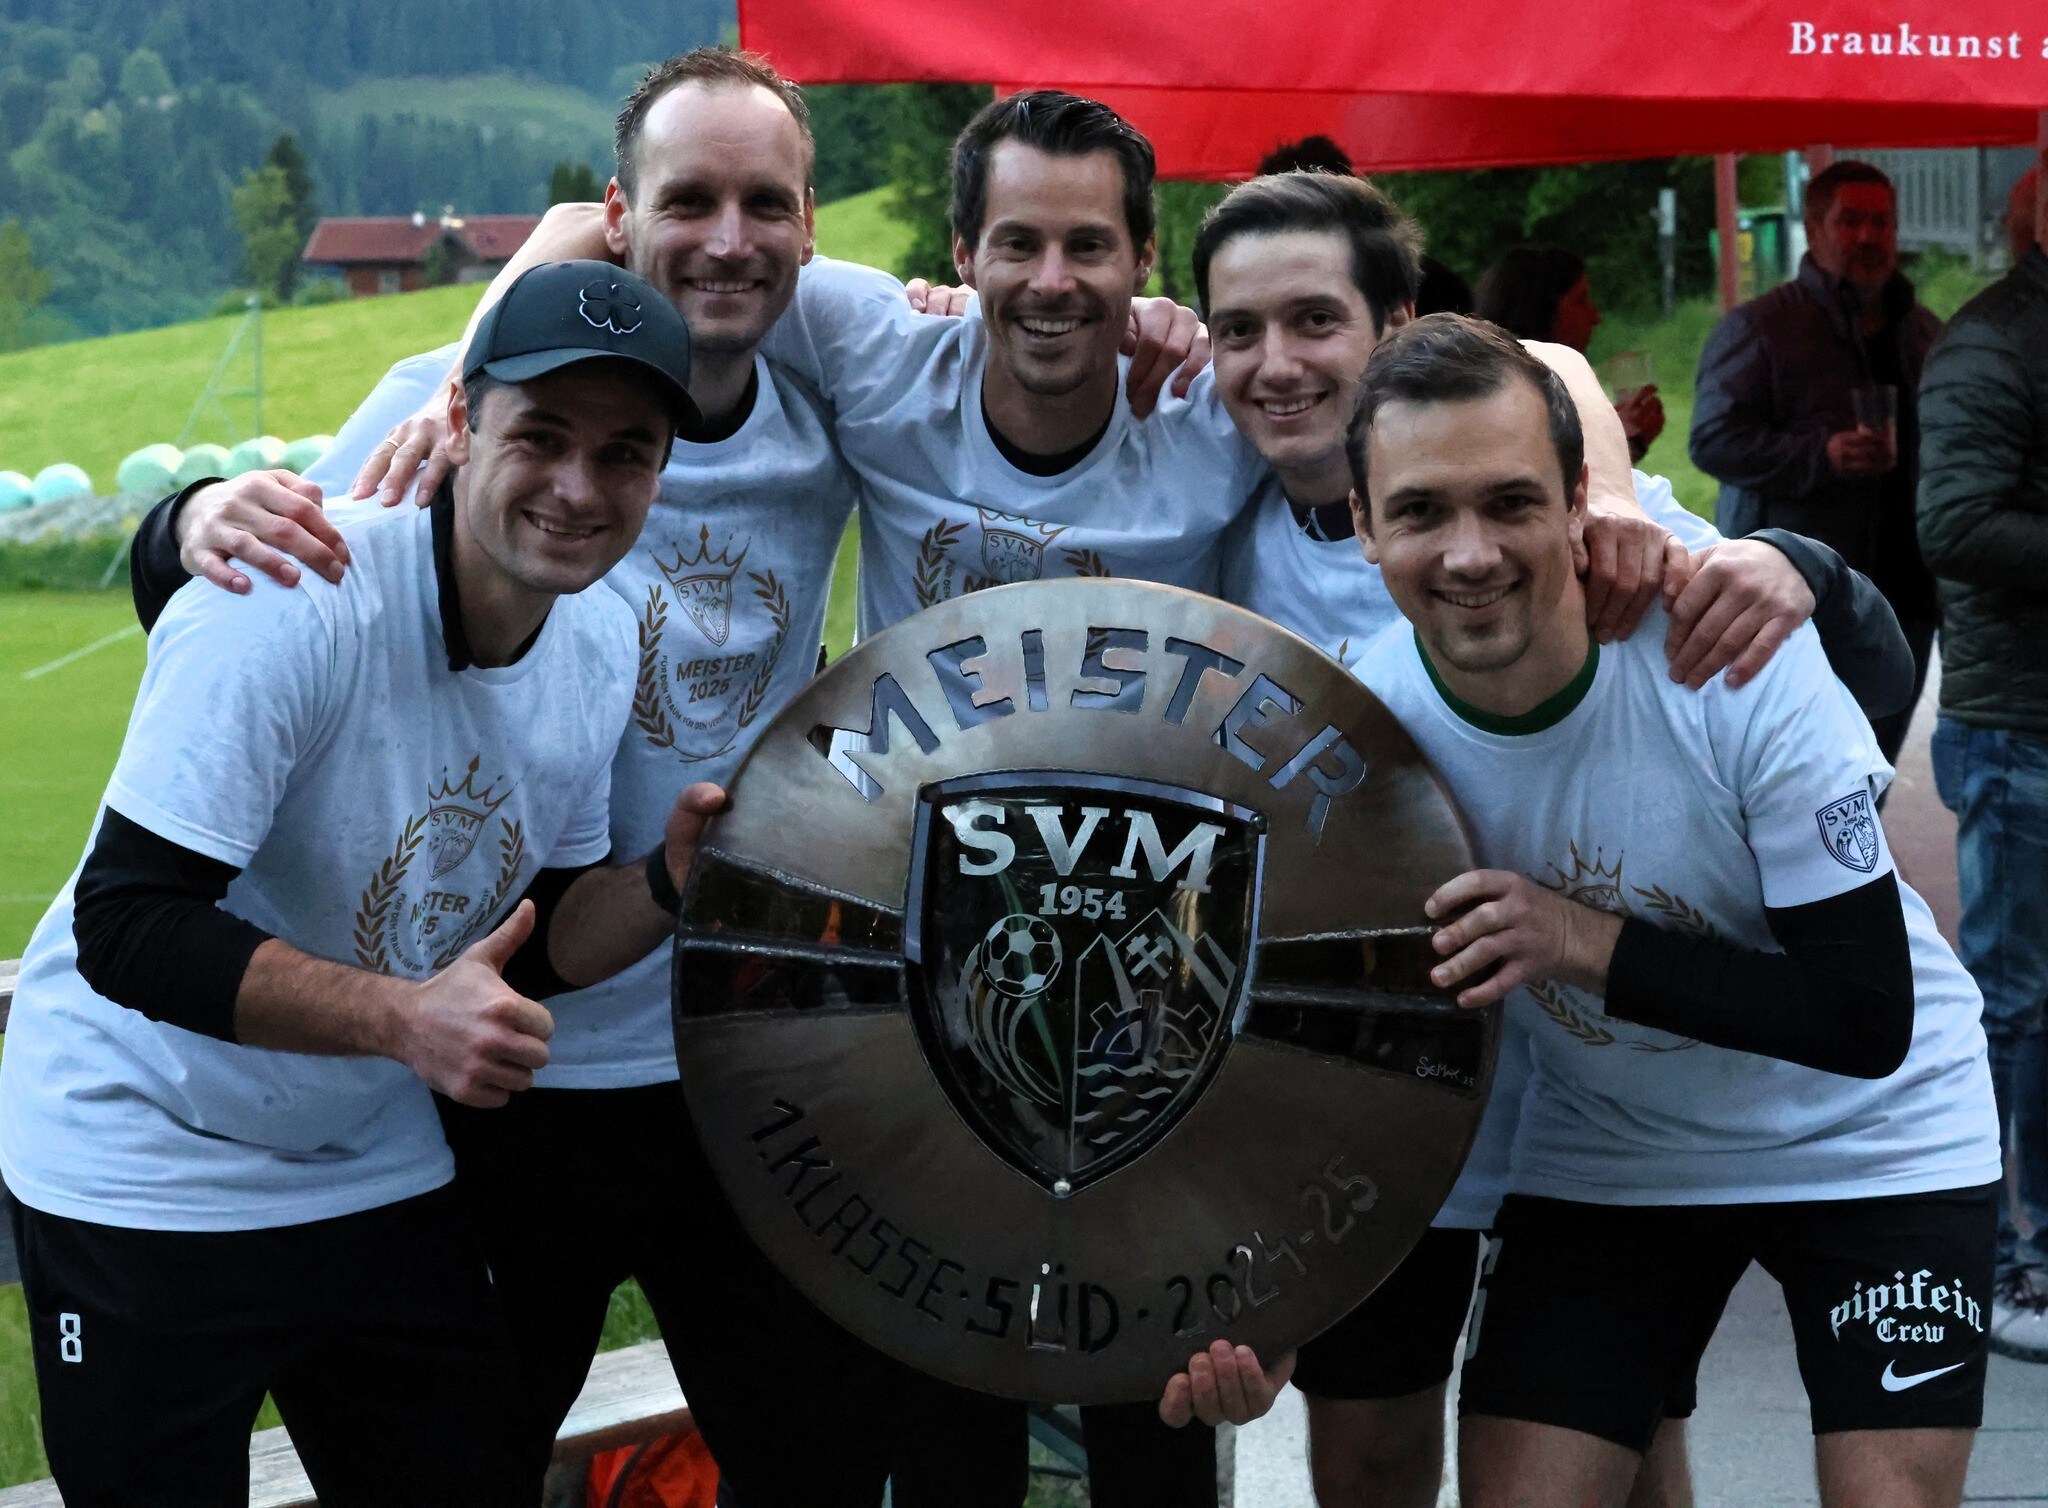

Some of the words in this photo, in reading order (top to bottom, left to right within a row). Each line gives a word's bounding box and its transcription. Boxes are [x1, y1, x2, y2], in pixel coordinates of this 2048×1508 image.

[1789, 21, 2022, 59] Braukunst
[989, 535, 1035, 557] SVM
[680, 581, 724, 599] SVM
[676, 653, 756, 682] MEISTER
[688, 677, 732, 703] 2025
[806, 626, 1366, 847] MEISTER
[431, 812, 477, 831] SVM
[1824, 796, 1865, 827] SVM
[953, 802, 1227, 894] SVM
[1038, 882, 1127, 920] 1954
[1829, 1268, 1984, 1344] pipifein
[60, 1312, 83, 1363] 8
[1876, 1316, 1946, 1343] Crew
